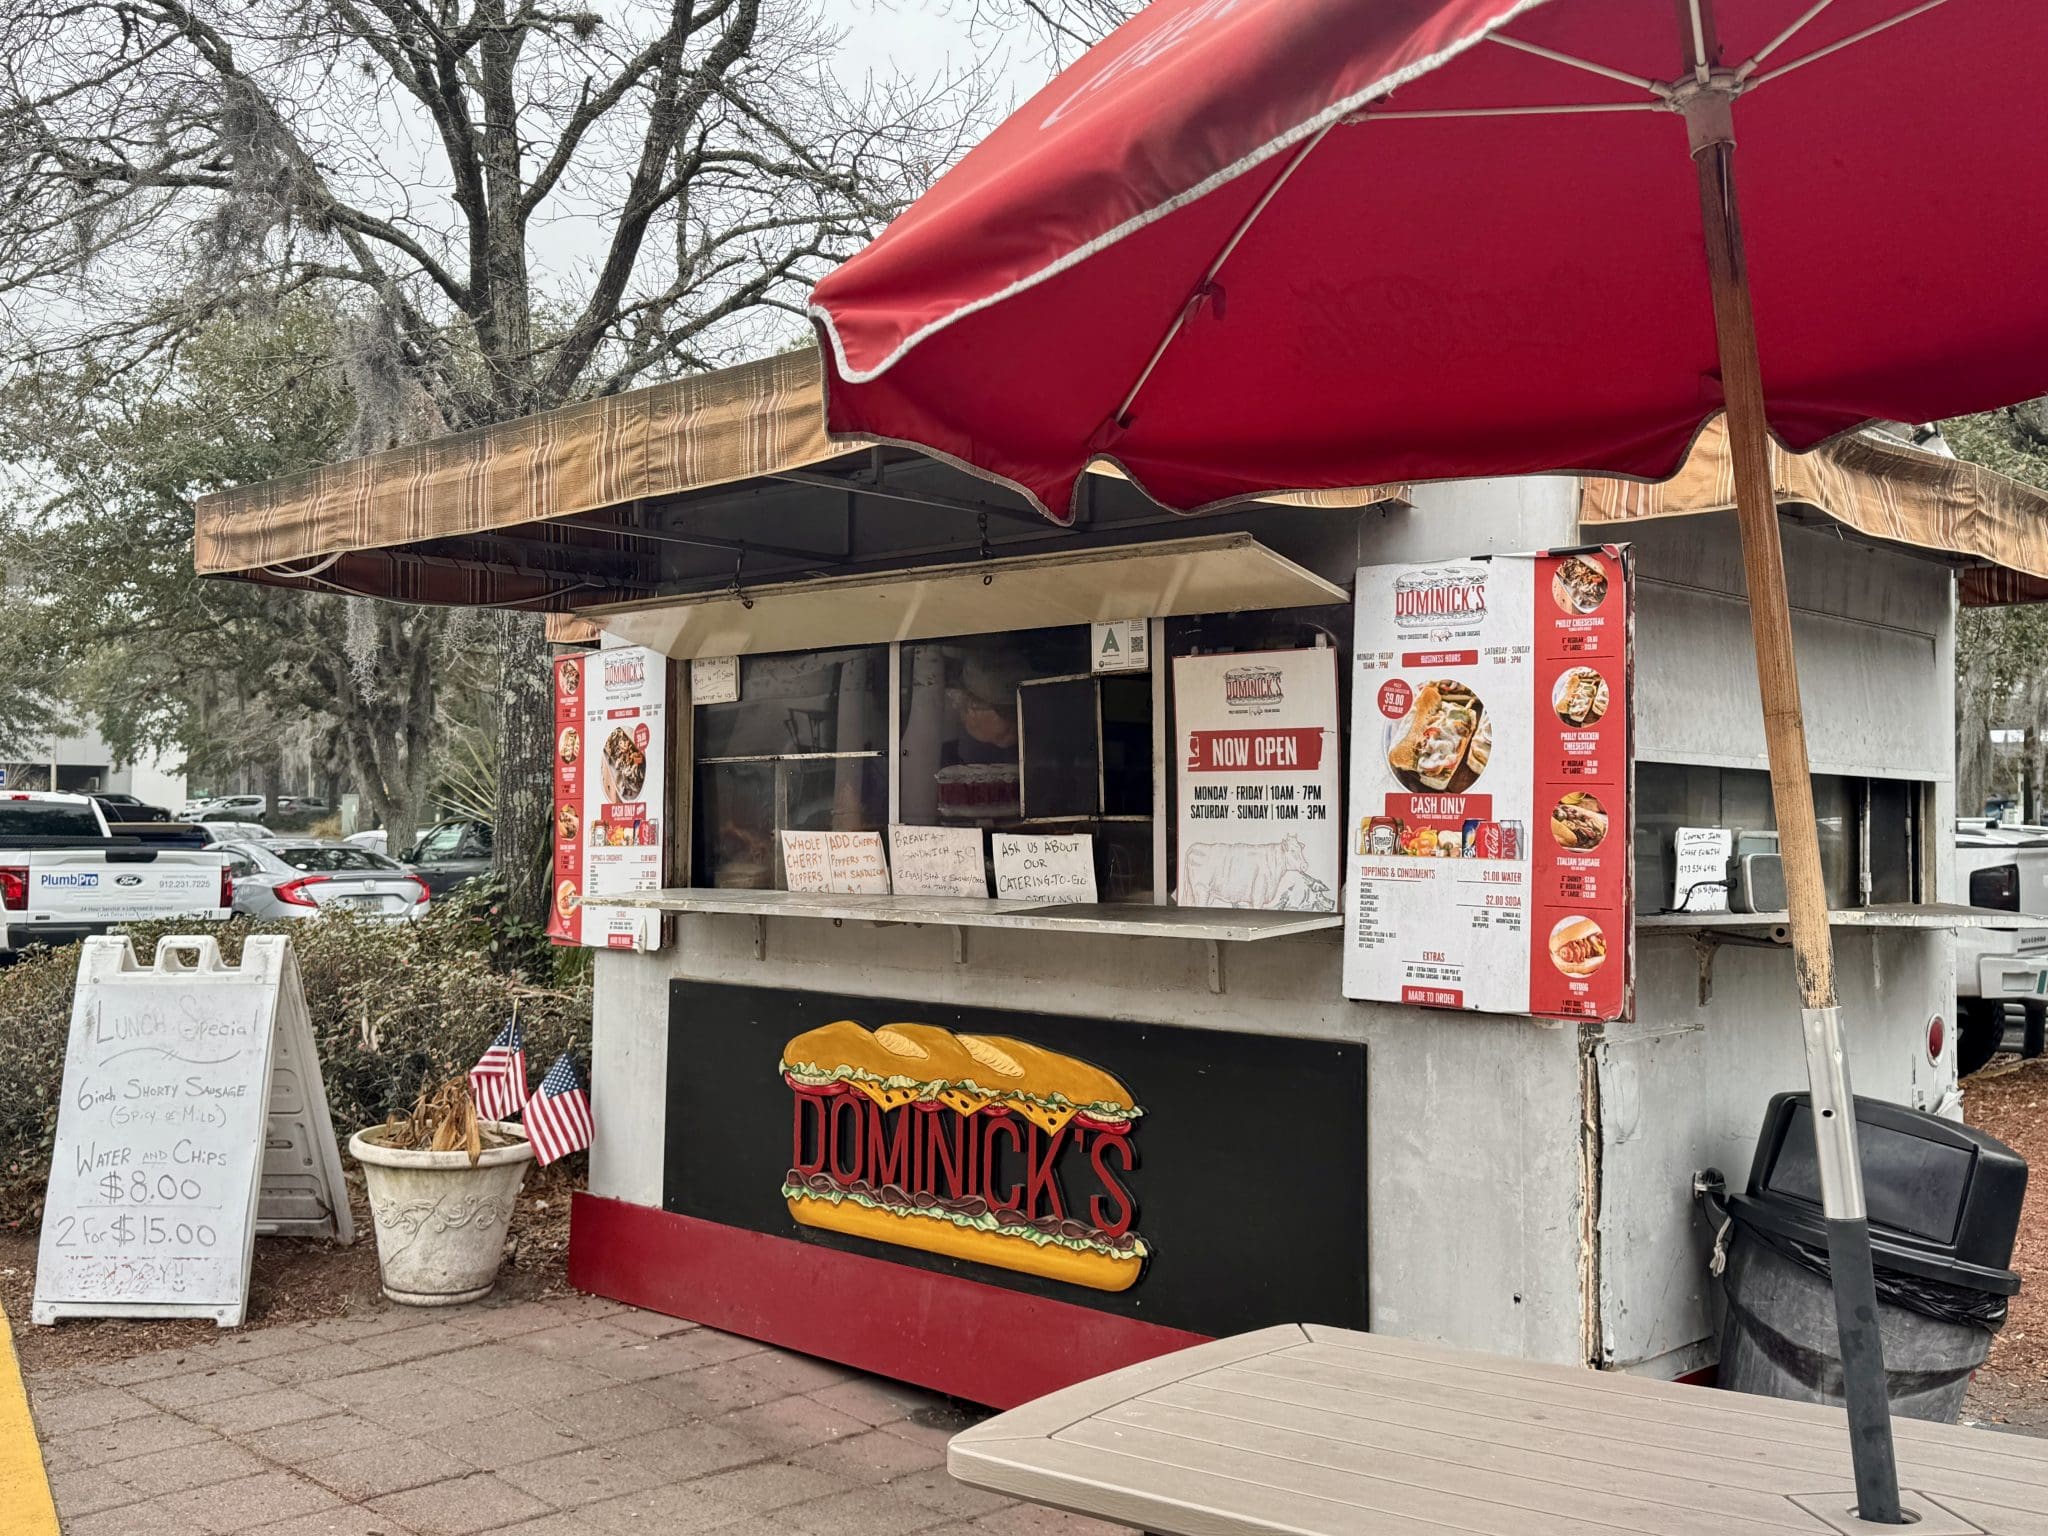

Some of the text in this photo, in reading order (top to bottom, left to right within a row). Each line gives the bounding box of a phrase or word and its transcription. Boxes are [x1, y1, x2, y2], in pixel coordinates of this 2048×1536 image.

[1396, 584, 1486, 617] DOMINICK'S
[1101, 627, 1121, 653] A
[1226, 677, 1282, 698] DOMINICK'S
[1384, 691, 1405, 707] $9.00
[1212, 736, 1298, 767] NOW OPEN
[1194, 784, 1322, 801] MONDAY FRIDAY 10AM 7PM
[611, 805, 624, 818] CASH
[624, 804, 636, 817] ONLY
[1190, 804, 1326, 820] SATURDAY SUNDAY 10AM 3PM
[1411, 796, 1466, 815] CASH ONLY
[784, 835, 821, 851] WHOLE
[829, 834, 850, 851] ADD
[1001, 839, 1080, 858] ASK US ABOUT
[786, 853, 823, 869] CHERRY
[862, 855, 876, 863] TO
[1023, 858, 1048, 870] OUR
[41, 873, 99, 887] PlumbPro
[789, 871, 824, 887] PEPPERS
[833, 871, 847, 880] ANY
[1361, 866, 1436, 880] TOPPINGS & CONDIMENTS
[1482, 870, 1522, 883] $1.00 WATER
[1485, 894, 1522, 907] $2.00 SODA
[1423, 950, 1446, 962] EXTRAS
[1407, 990, 1456, 1005] MADE TO ORDER
[97, 994, 259, 1044] LUNCH Special
[123, 1078, 178, 1100] SHORTY
[185, 1076, 248, 1098] SAUSAGE
[76, 1141, 132, 1177] WATER
[142, 1149, 168, 1161] AND
[793, 1090, 1133, 1237] DOMINICK'S
[100, 1170, 202, 1204] $8.00
[55, 1215, 77, 1247] 2
[110, 1213, 217, 1247] $15.00
